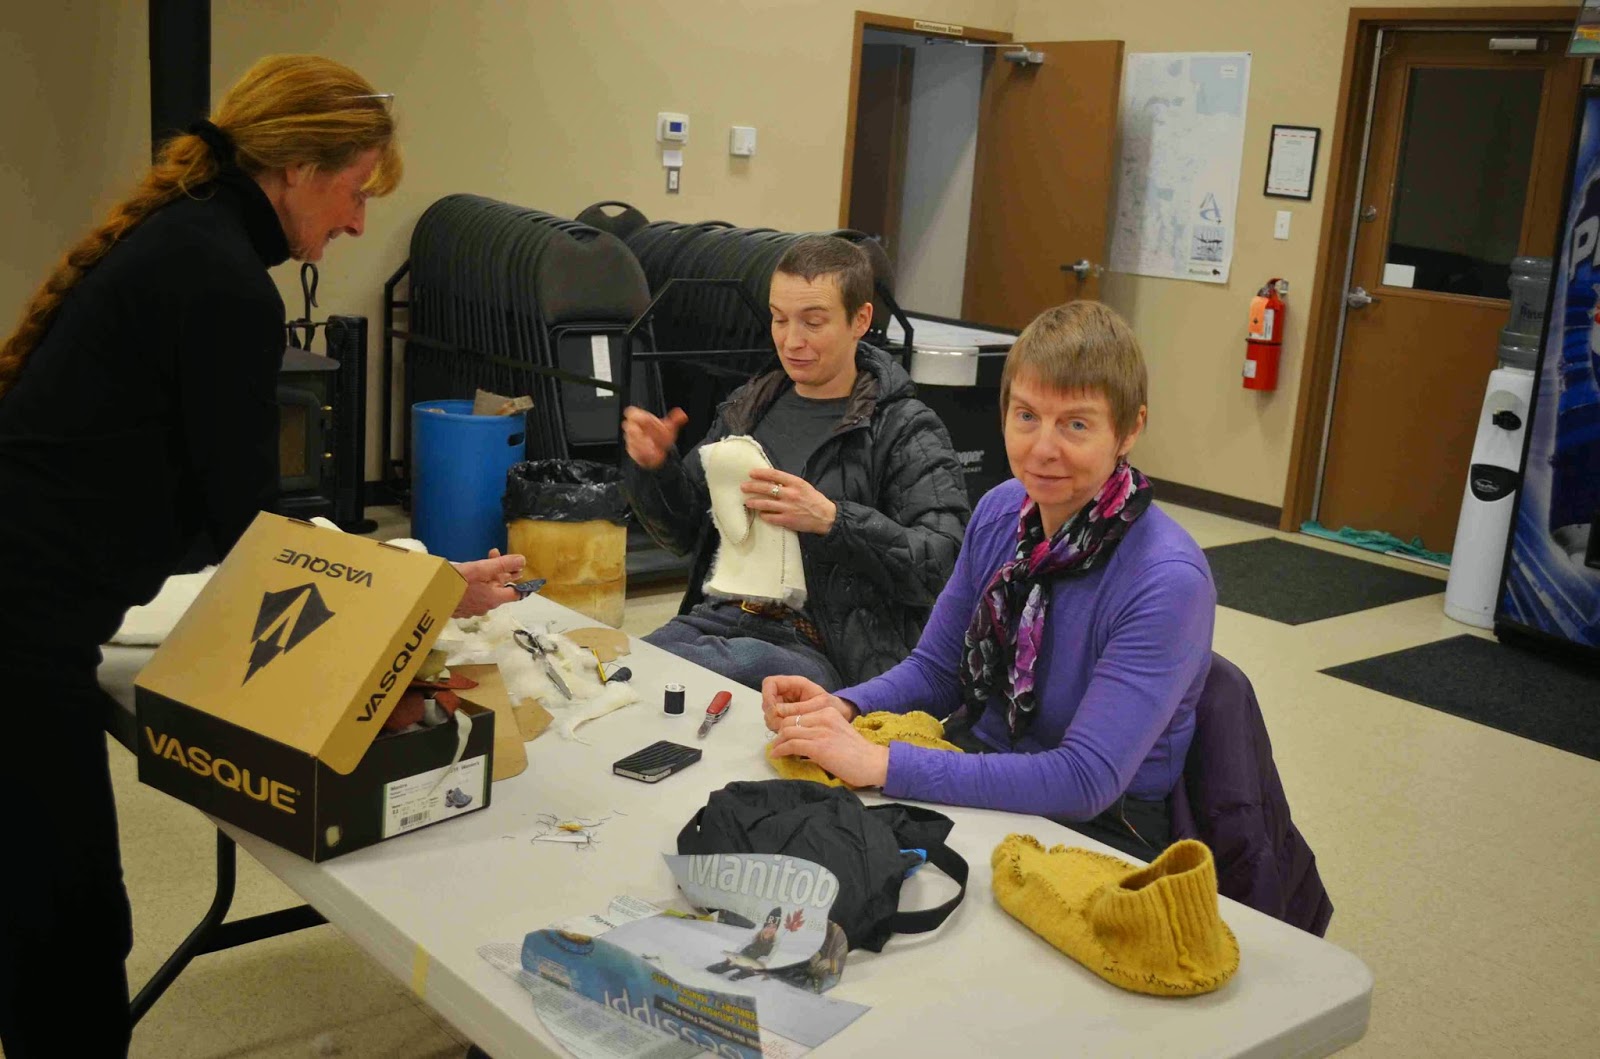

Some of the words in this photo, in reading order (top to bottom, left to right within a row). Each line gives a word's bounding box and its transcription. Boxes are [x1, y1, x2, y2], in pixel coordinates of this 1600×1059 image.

[276, 548, 374, 588] VASQUE
[356, 612, 436, 722] VASQUE
[145, 726, 297, 814] VASQUE
